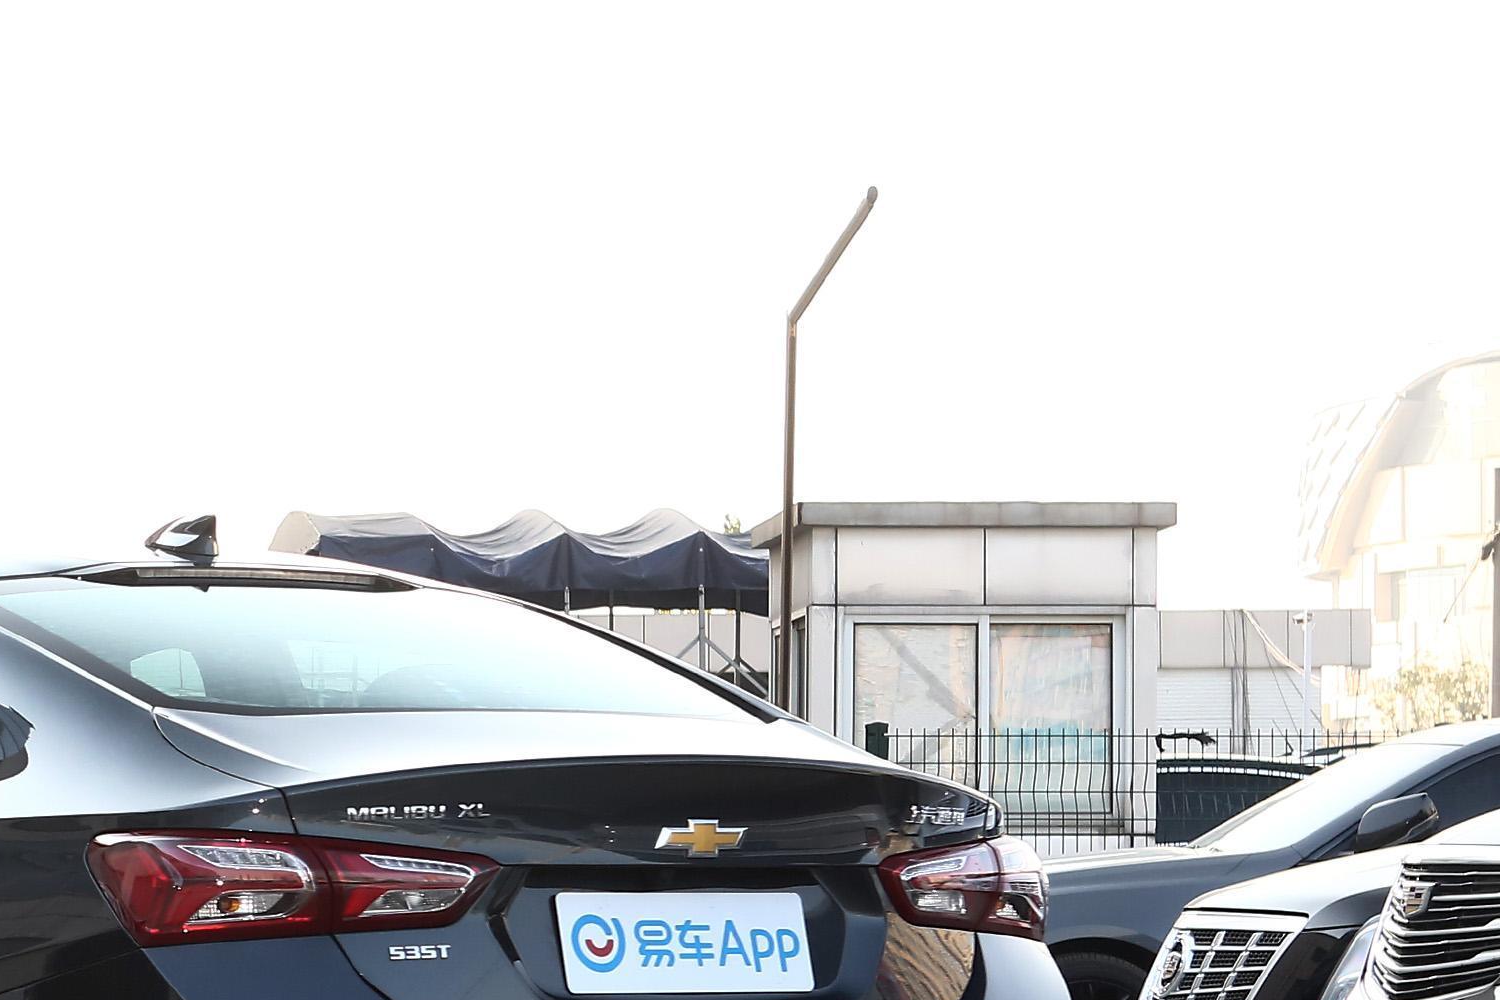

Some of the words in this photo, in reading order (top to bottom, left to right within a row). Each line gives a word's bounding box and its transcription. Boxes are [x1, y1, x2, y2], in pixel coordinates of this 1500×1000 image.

[346, 805, 447, 819] MALIBU
[457, 803, 491, 818] XL
[389, 944, 452, 960] 535T
[633, 919, 801, 972] 易车App
